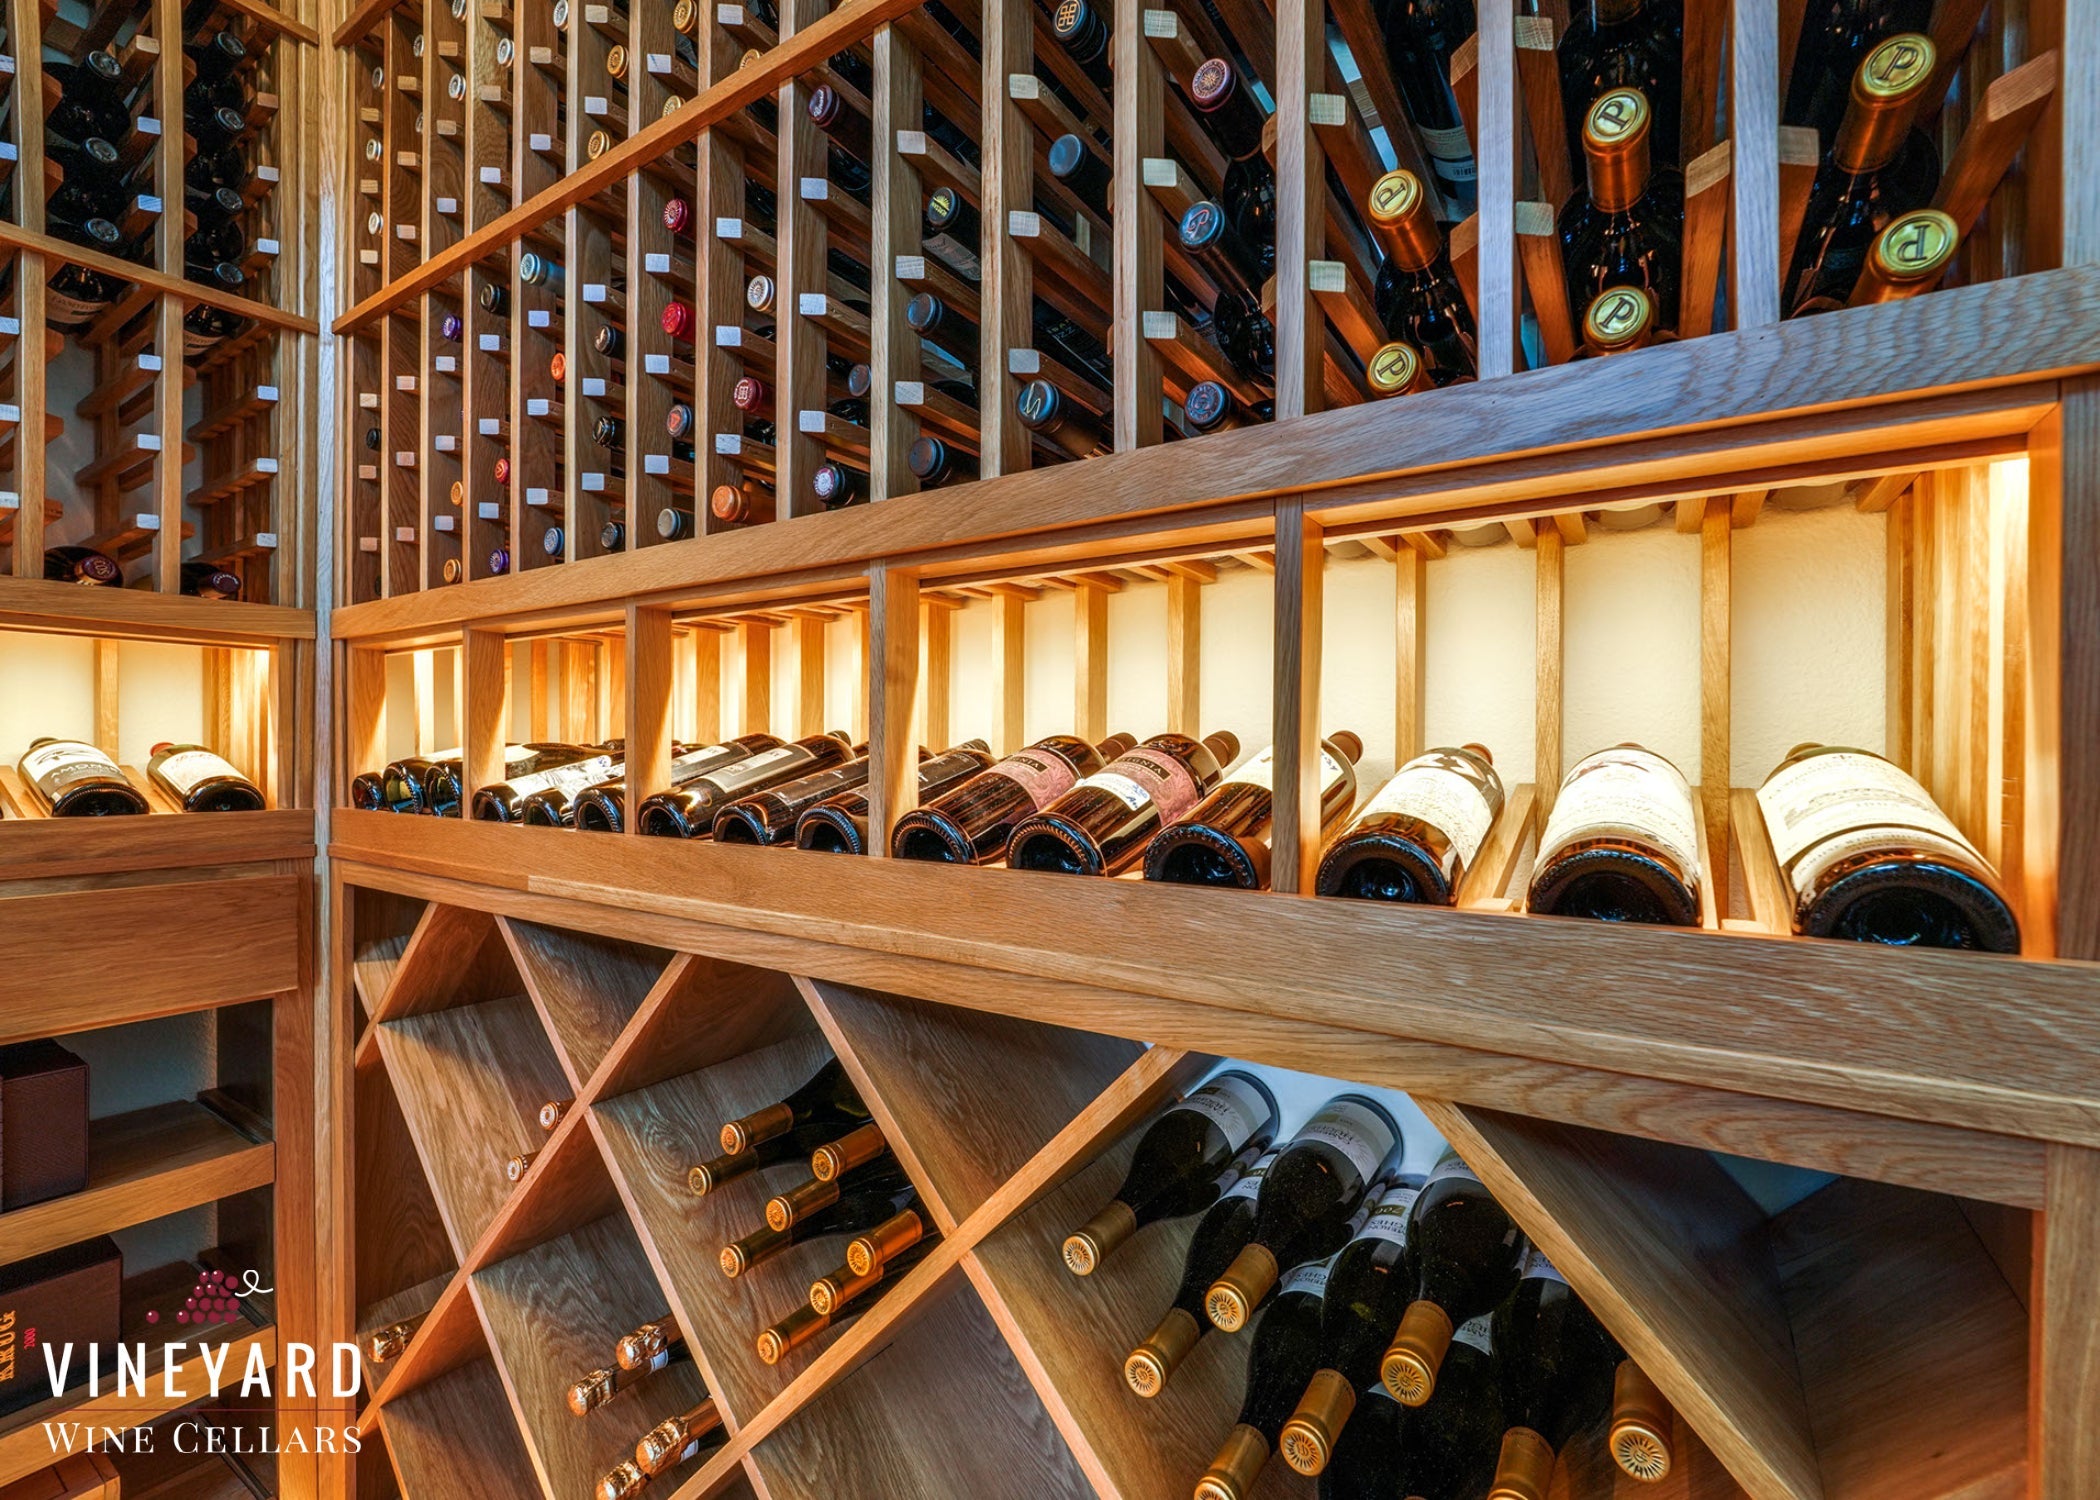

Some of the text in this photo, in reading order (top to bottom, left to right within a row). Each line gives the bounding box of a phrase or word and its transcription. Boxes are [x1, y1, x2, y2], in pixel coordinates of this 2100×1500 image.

[1877, 46, 1918, 80] P
[1596, 100, 1630, 130] P
[1377, 183, 1406, 210] P
[1897, 224, 1931, 262] P
[1599, 297, 1635, 329] P
[1377, 353, 1406, 377] P
[1368, 1225, 1404, 1234] MERON
